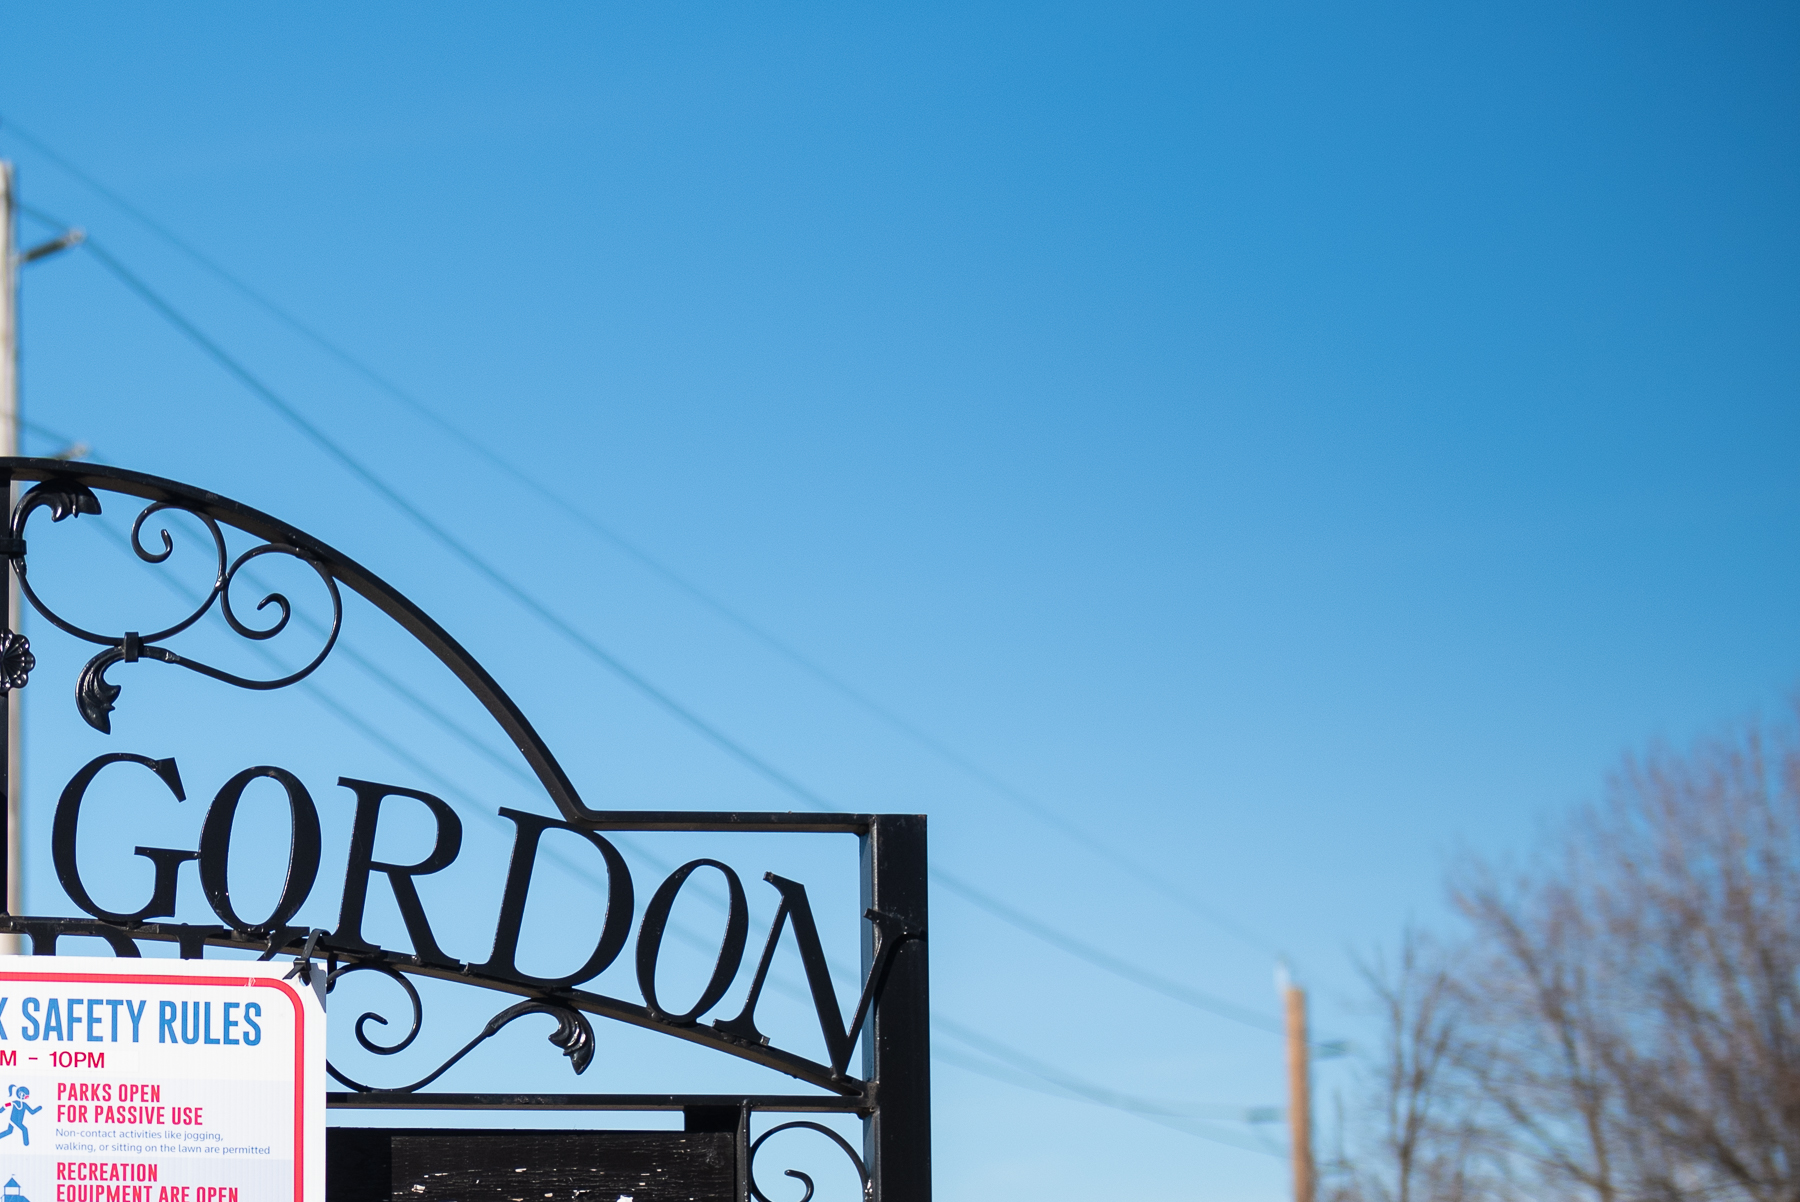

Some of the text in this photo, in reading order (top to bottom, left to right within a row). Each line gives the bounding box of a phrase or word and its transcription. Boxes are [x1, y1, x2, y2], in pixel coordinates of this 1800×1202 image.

[51, 753, 926, 1080] GORDON
[21, 997, 147, 1043] SAFETY
[158, 1000, 262, 1046] RULES
[49, 1051, 105, 1068] 10PM
[57, 1082, 160, 1102] PARKS OPEN
[57, 1104, 203, 1125] FOR PASSIVE USE
[55, 1128, 224, 1142] Non-contact activities like jogging,
[55, 1142, 96, 1152] walking,
[111, 1143, 142, 1154] sitting
[160, 1144, 176, 1152] the
[178, 1144, 202, 1152] lawn
[222, 1145, 271, 1156] permitted
[57, 1162, 158, 1182] RECREATION
